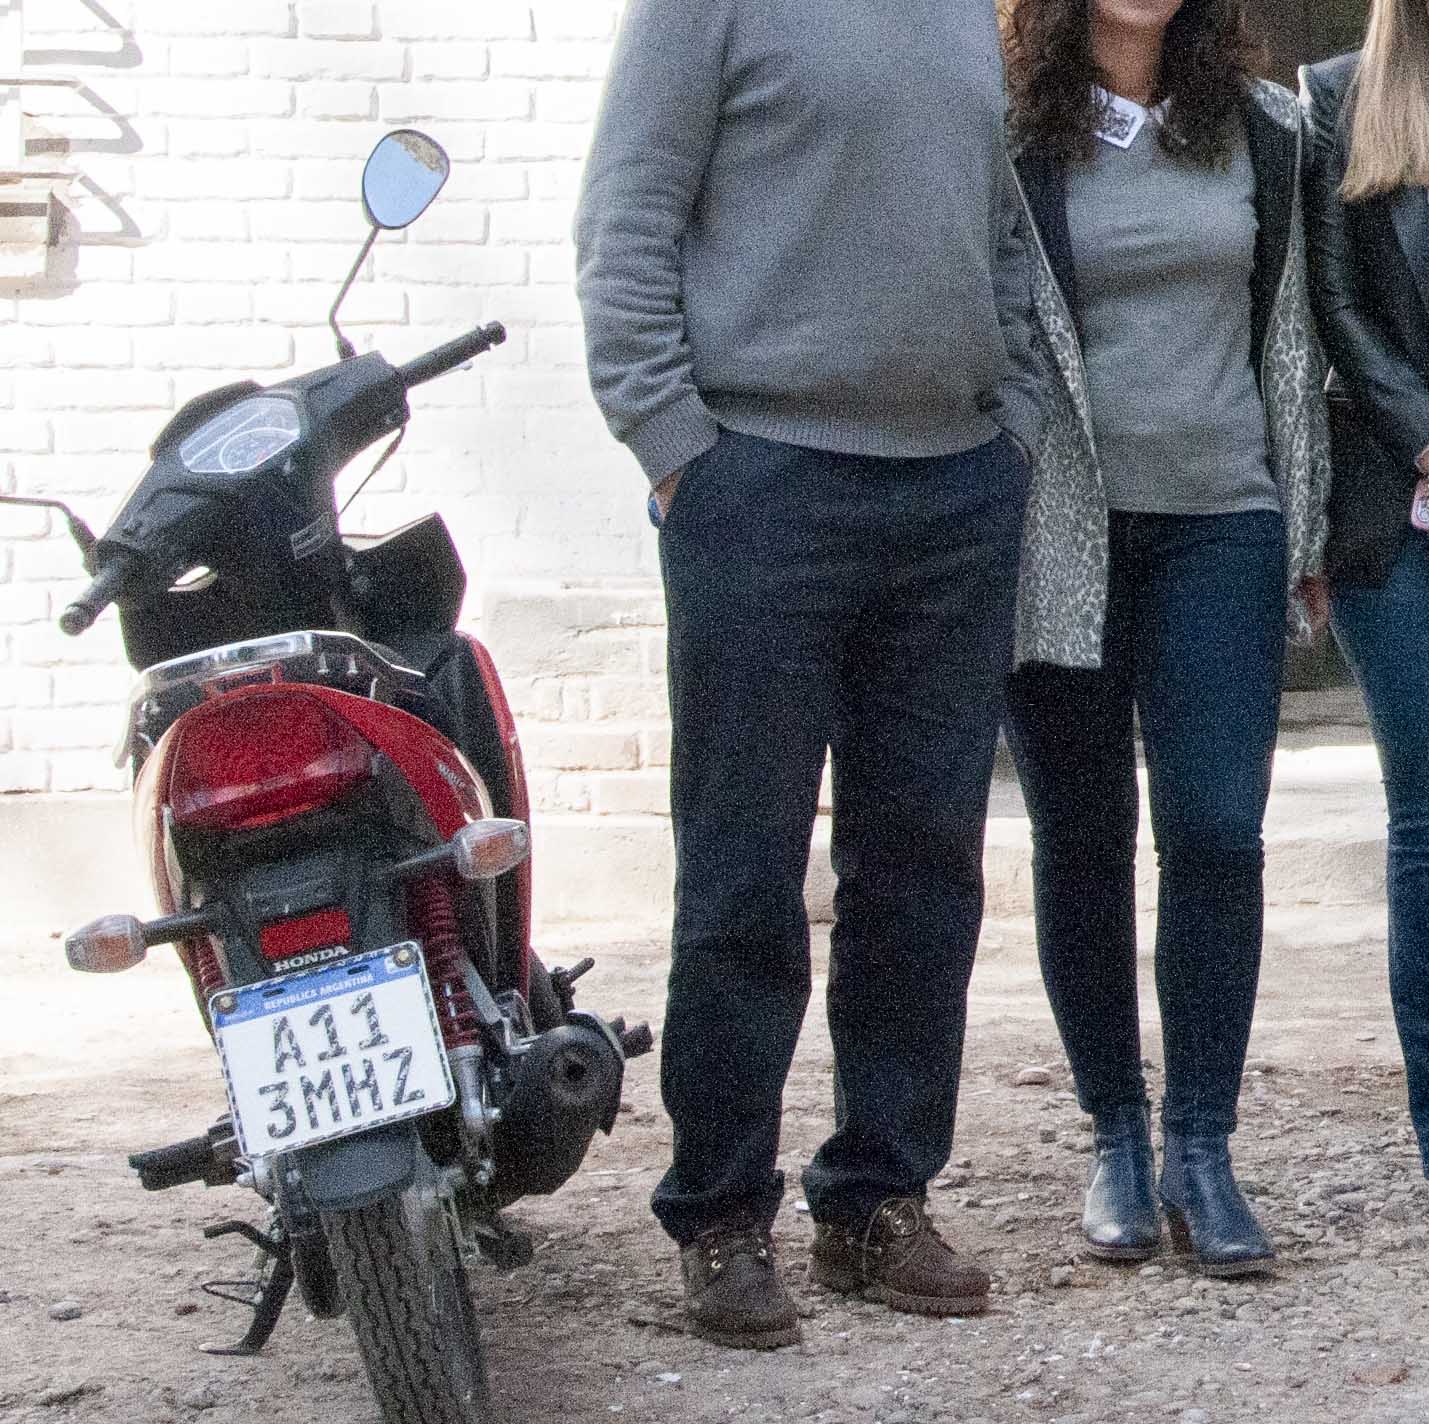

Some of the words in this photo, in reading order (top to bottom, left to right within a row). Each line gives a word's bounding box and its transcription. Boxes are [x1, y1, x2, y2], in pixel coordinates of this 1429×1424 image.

[273, 945, 350, 973] HONDA
[320, 974, 374, 997] ARGENTINA
[272, 992, 389, 1074] A11
[258, 1045, 425, 1139] 3MHZ
